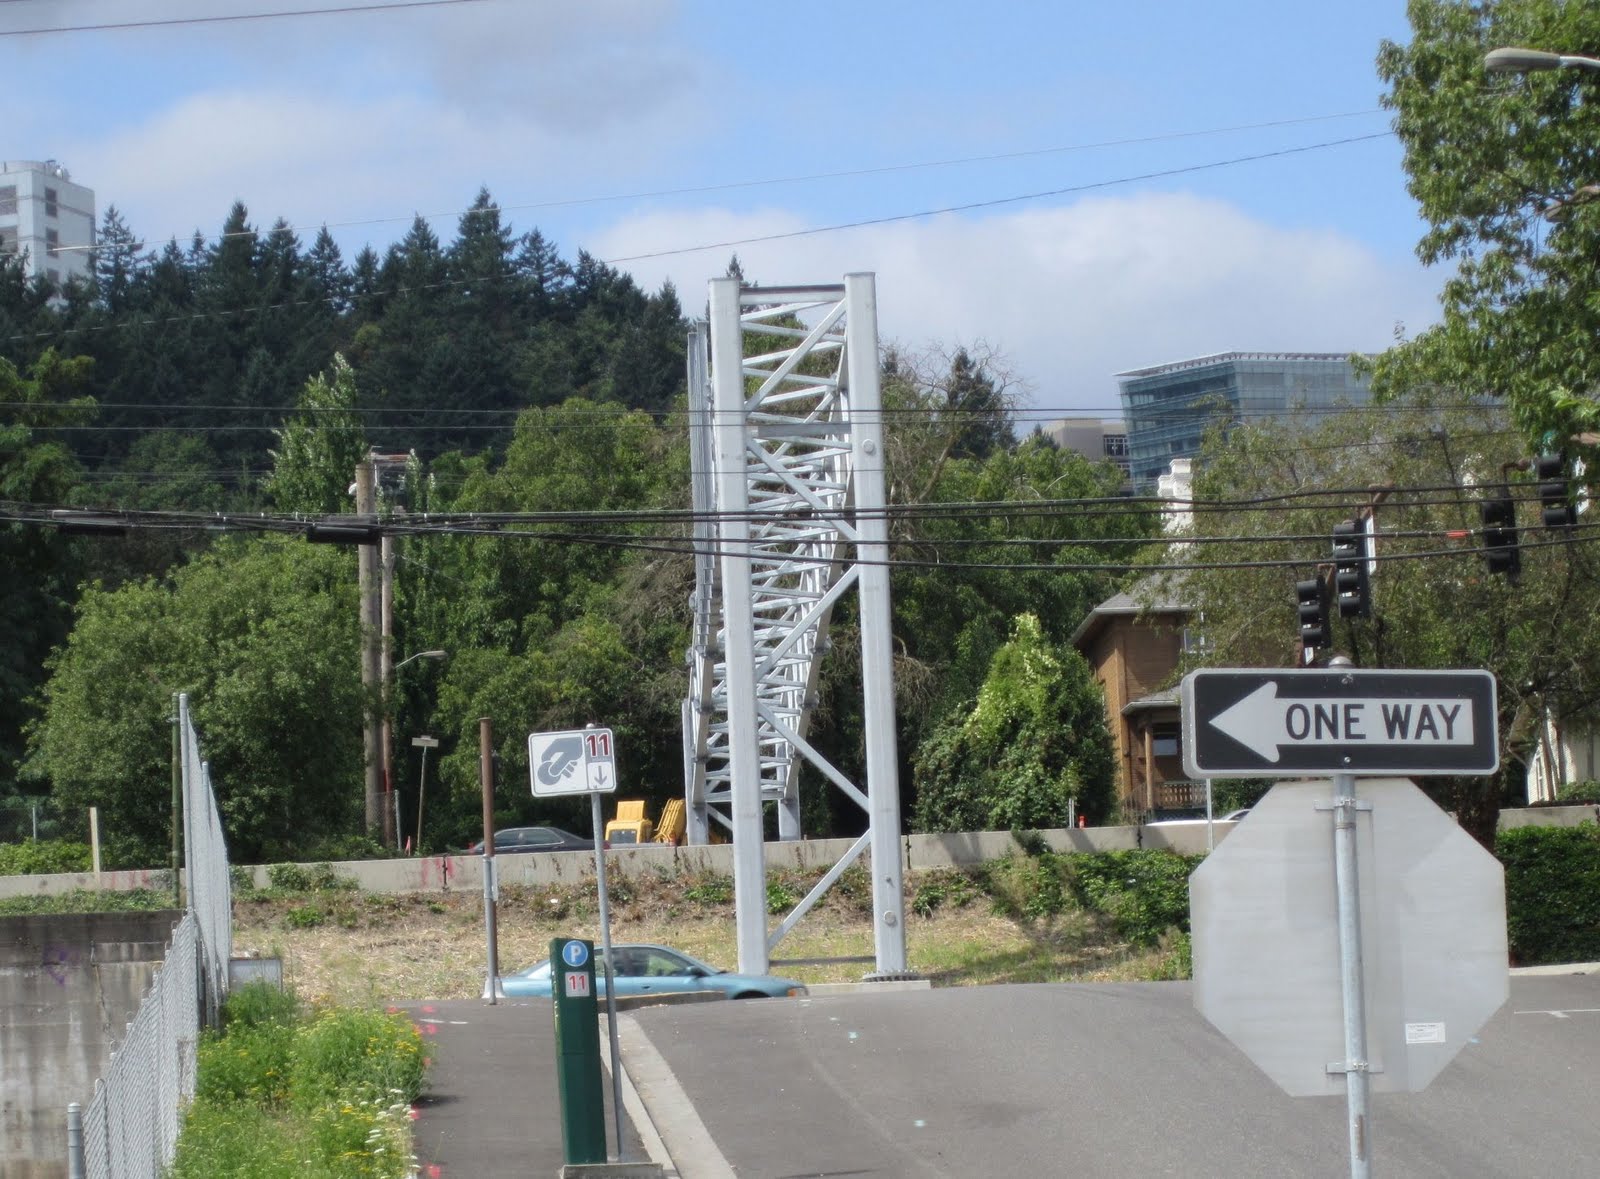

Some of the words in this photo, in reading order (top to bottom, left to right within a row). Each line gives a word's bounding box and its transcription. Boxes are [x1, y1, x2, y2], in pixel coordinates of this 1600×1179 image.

[1285, 703, 1366, 741] ONE
[1381, 703, 1461, 741] WAY
[586, 733, 609, 757] 11
[570, 945, 582, 963] P
[568, 975, 586, 990] 11
